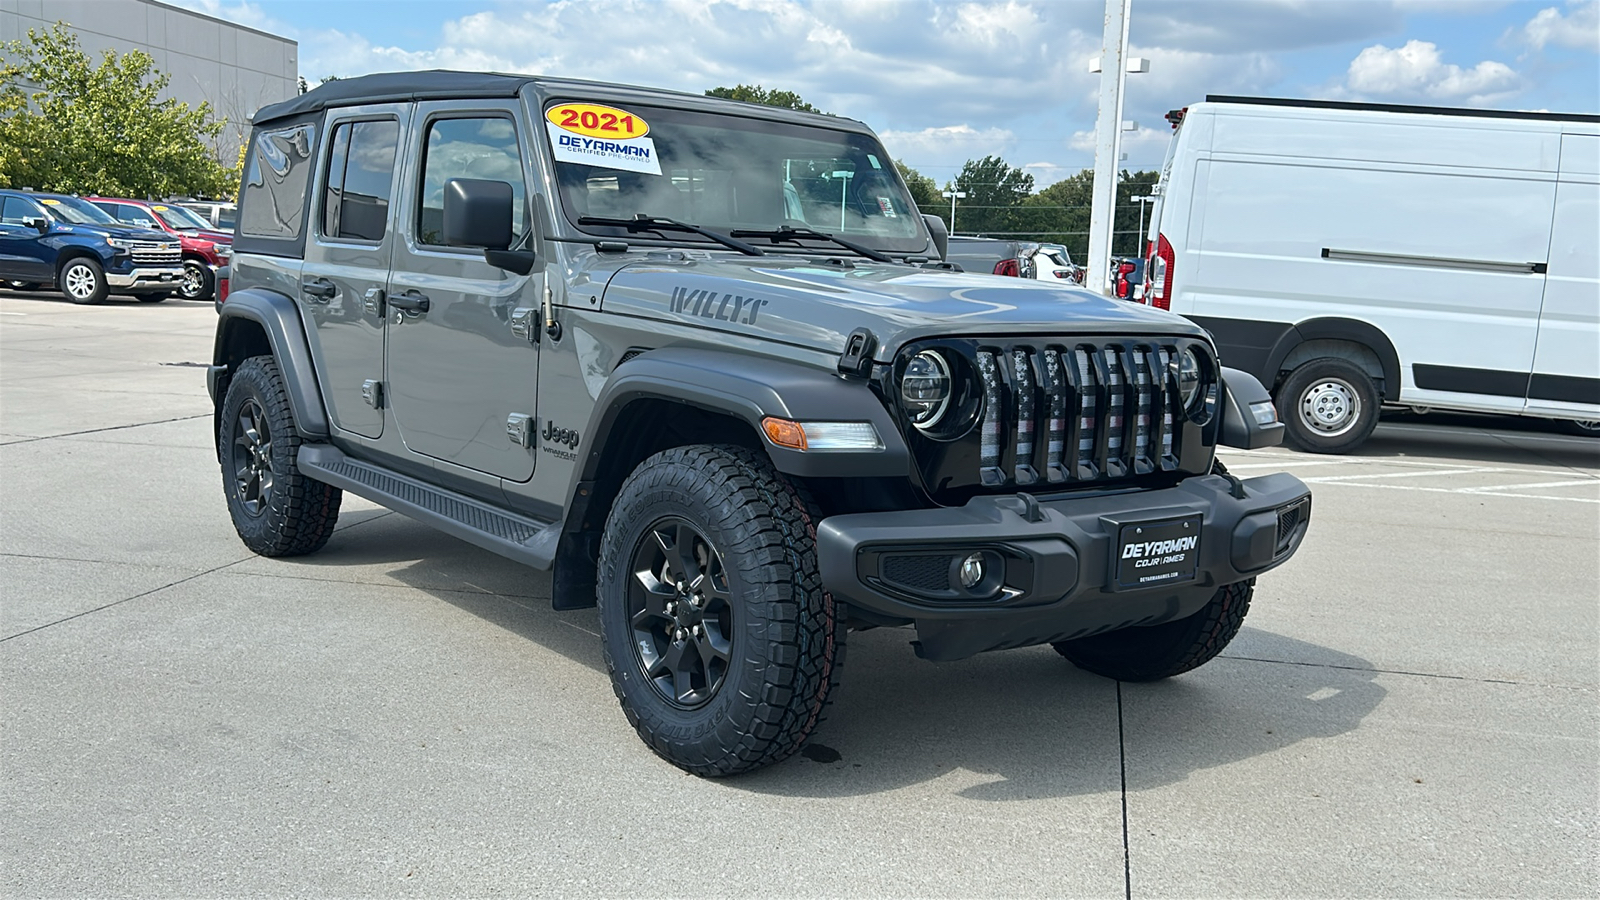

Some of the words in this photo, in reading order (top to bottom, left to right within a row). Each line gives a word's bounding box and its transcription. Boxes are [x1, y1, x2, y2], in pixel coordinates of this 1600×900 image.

[560, 109, 634, 133] 2021
[558, 135, 650, 158] DEYARMAN
[567, 146, 606, 157] CERTIFIED
[607, 152, 651, 163] PRE-OWNED
[669, 286, 769, 325] WILLYS
[542, 420, 580, 450] Jeep
[1121, 535, 1198, 559] DEYARMAN
[1162, 553, 1185, 564] AMES
